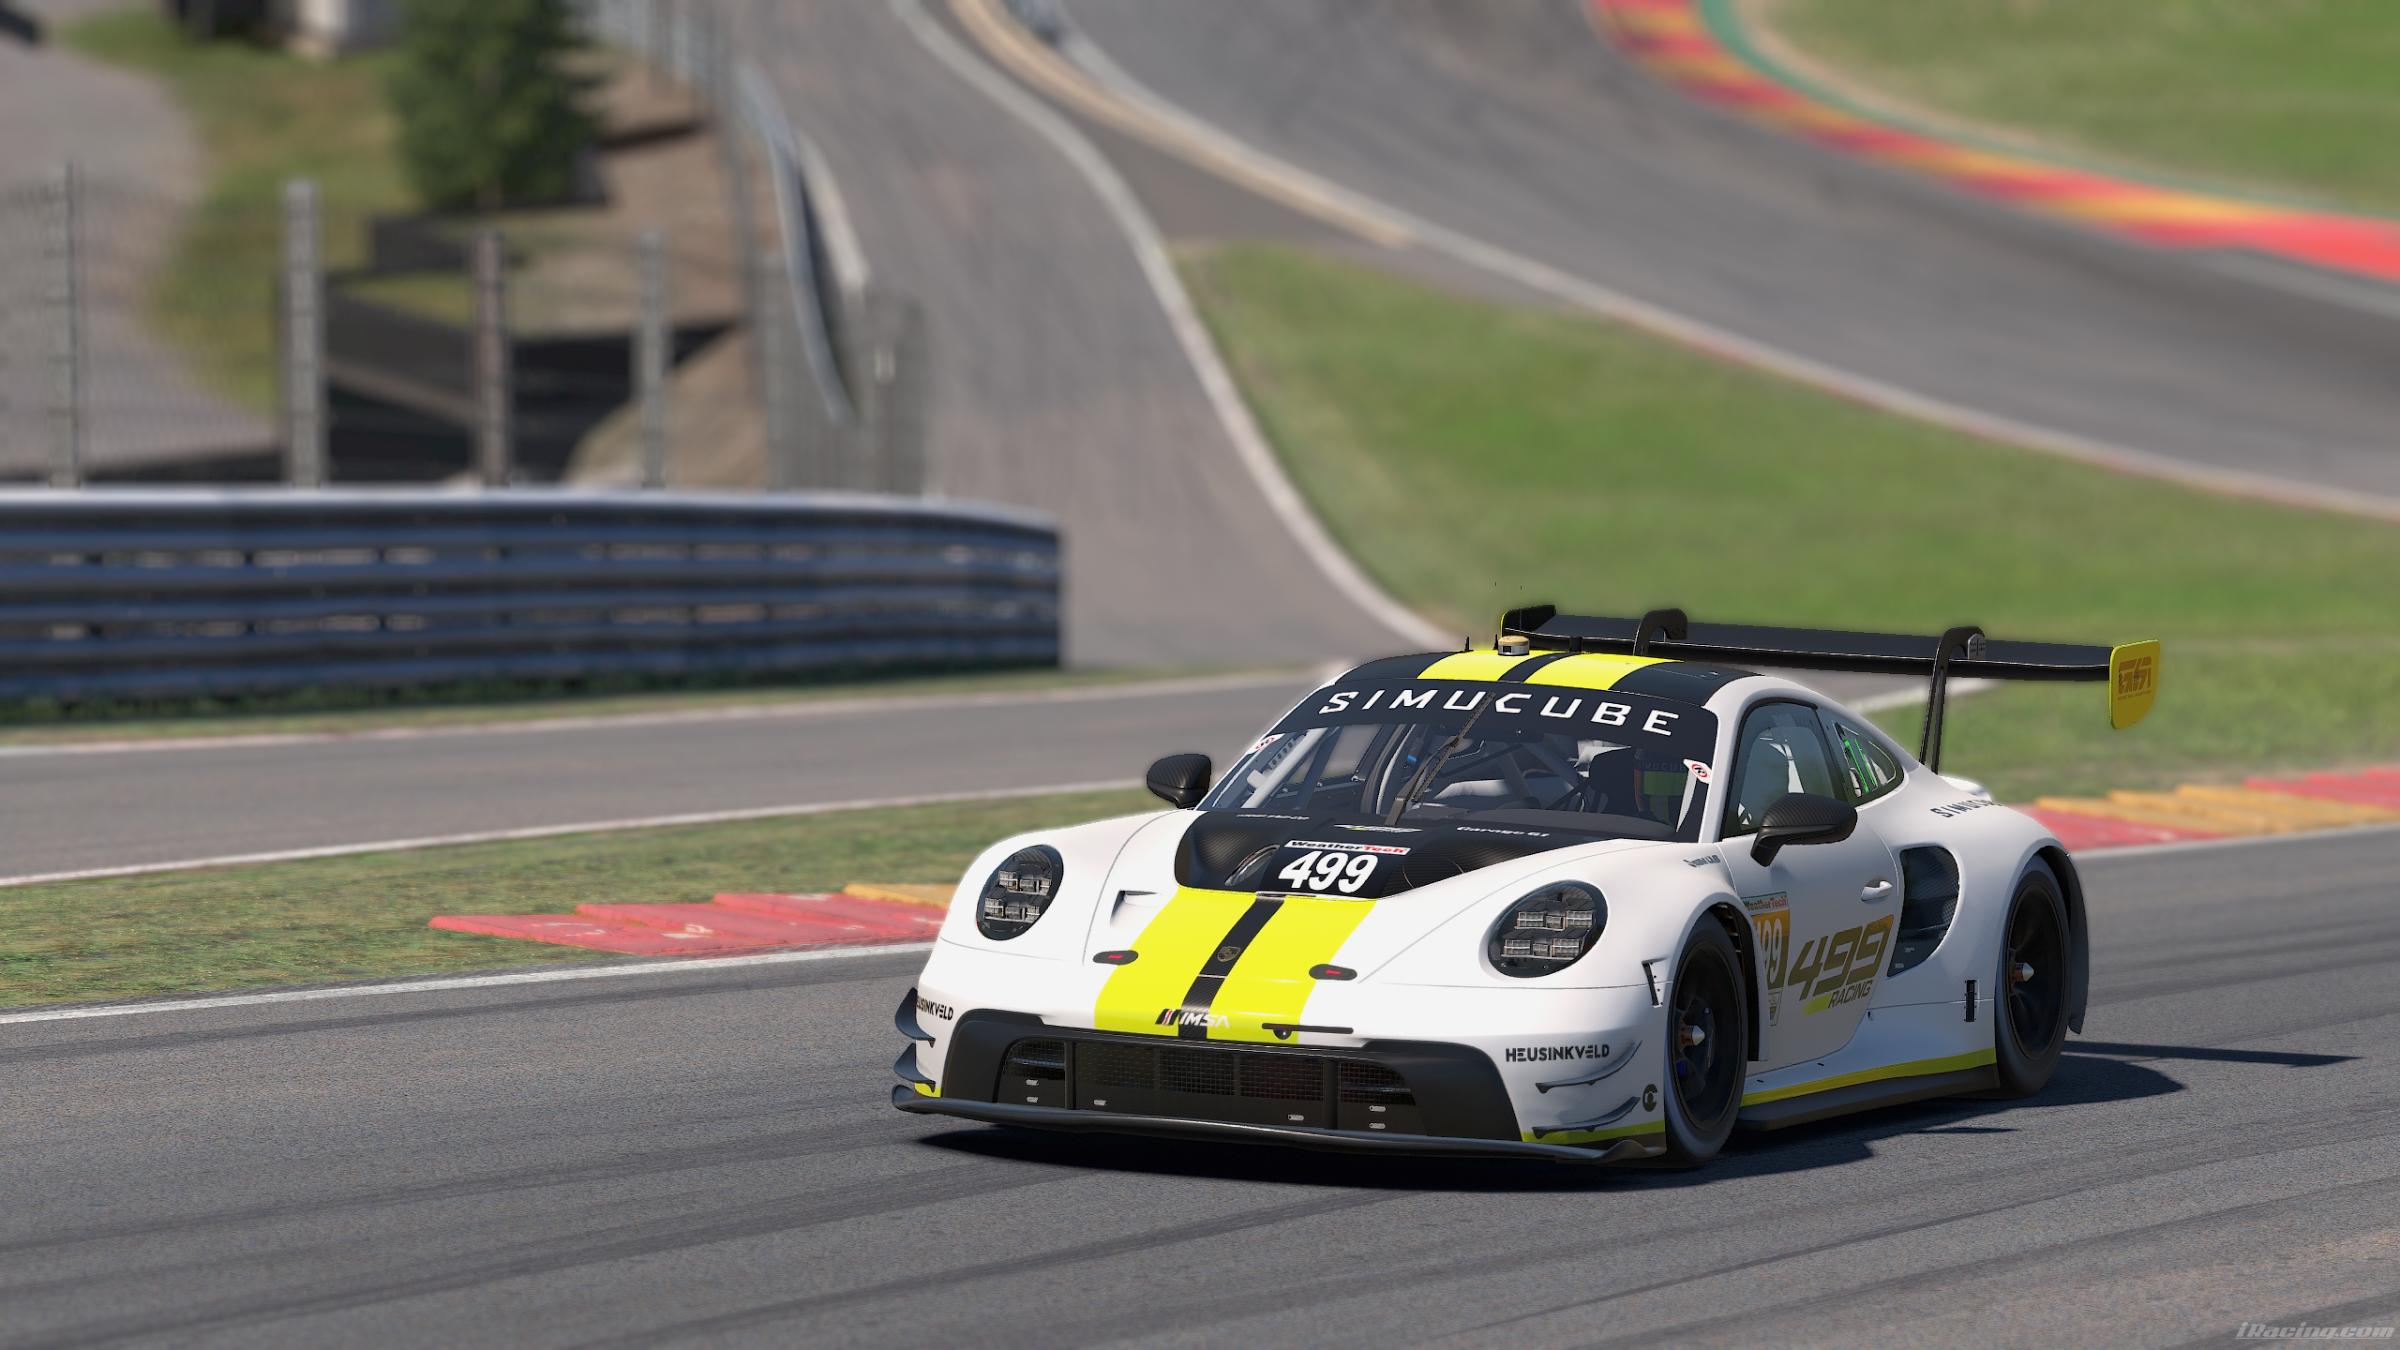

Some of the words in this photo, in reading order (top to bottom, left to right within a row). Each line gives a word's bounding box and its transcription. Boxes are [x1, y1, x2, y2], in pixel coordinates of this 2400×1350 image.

[1318, 690, 1680, 736] SIMUCUBE
[1291, 841, 1406, 854] WeatherTech
[1277, 850, 1379, 893] 499
[1787, 914, 1895, 1001] 499
[1827, 979, 1874, 1009] RACING
[1178, 1011, 1230, 1029] IMSA
[1505, 1043, 1611, 1063] HEUSINKVELD
